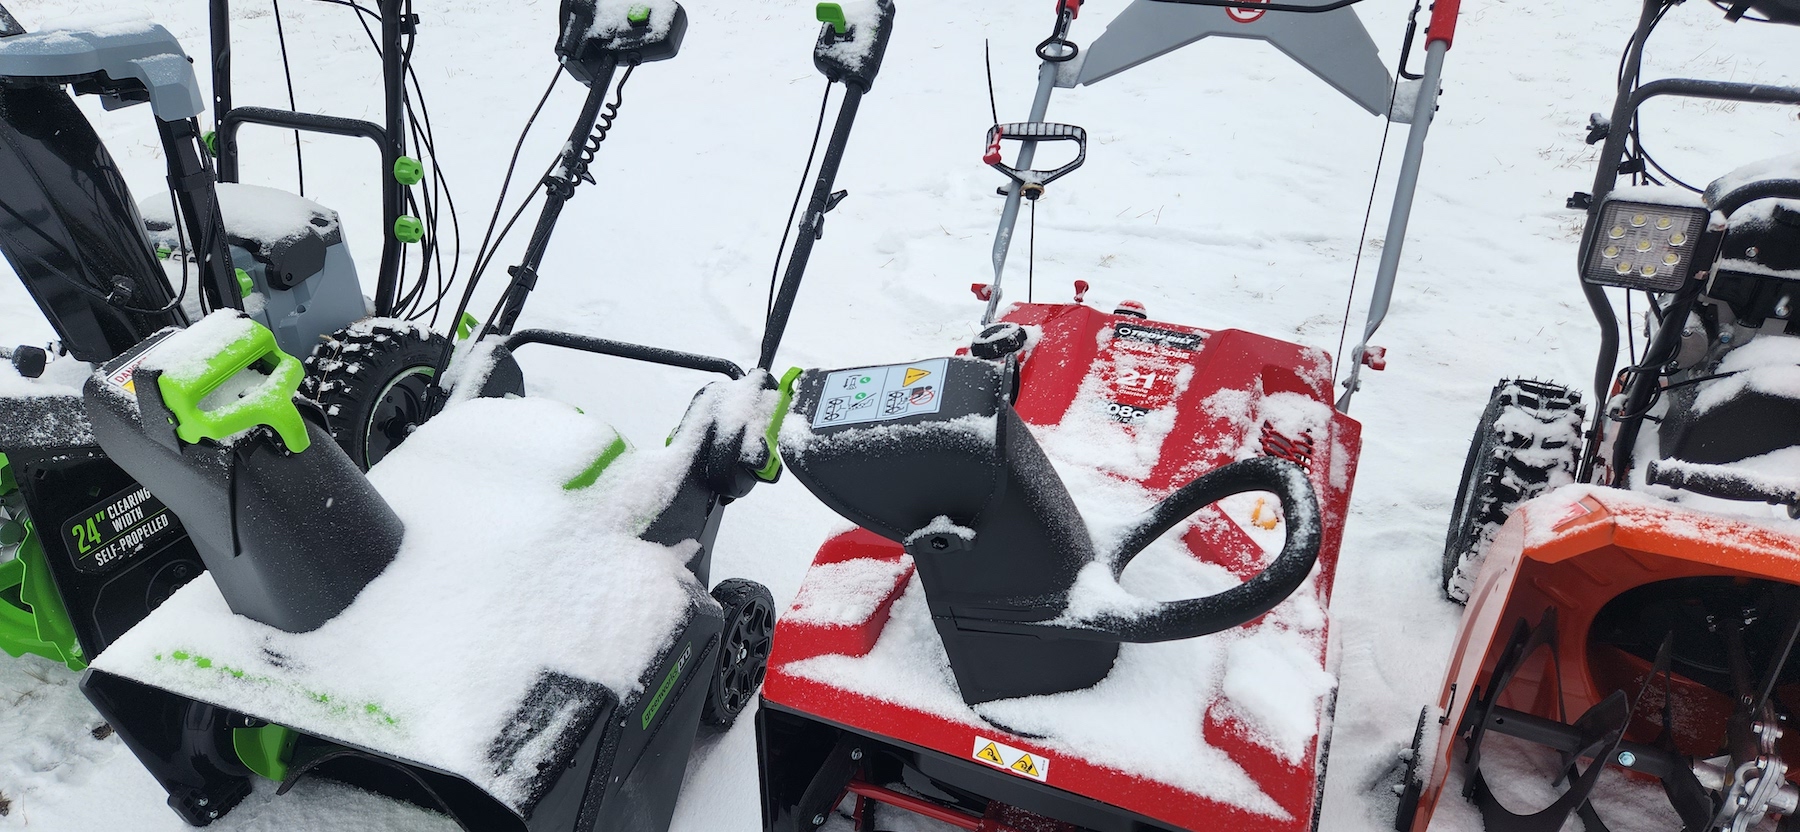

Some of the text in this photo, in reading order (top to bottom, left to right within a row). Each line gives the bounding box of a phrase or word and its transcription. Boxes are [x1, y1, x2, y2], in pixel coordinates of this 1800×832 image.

[1113, 341, 1159, 354] SQUALL
[1114, 369, 1169, 390] 21"
[106, 487, 151, 520] CLEARING
[111, 506, 144, 533] WIDTH
[71, 510, 106, 554] 24"
[94, 514, 169, 567] SELF-PROPELLED
[644, 646, 691, 723] greenworks pro
